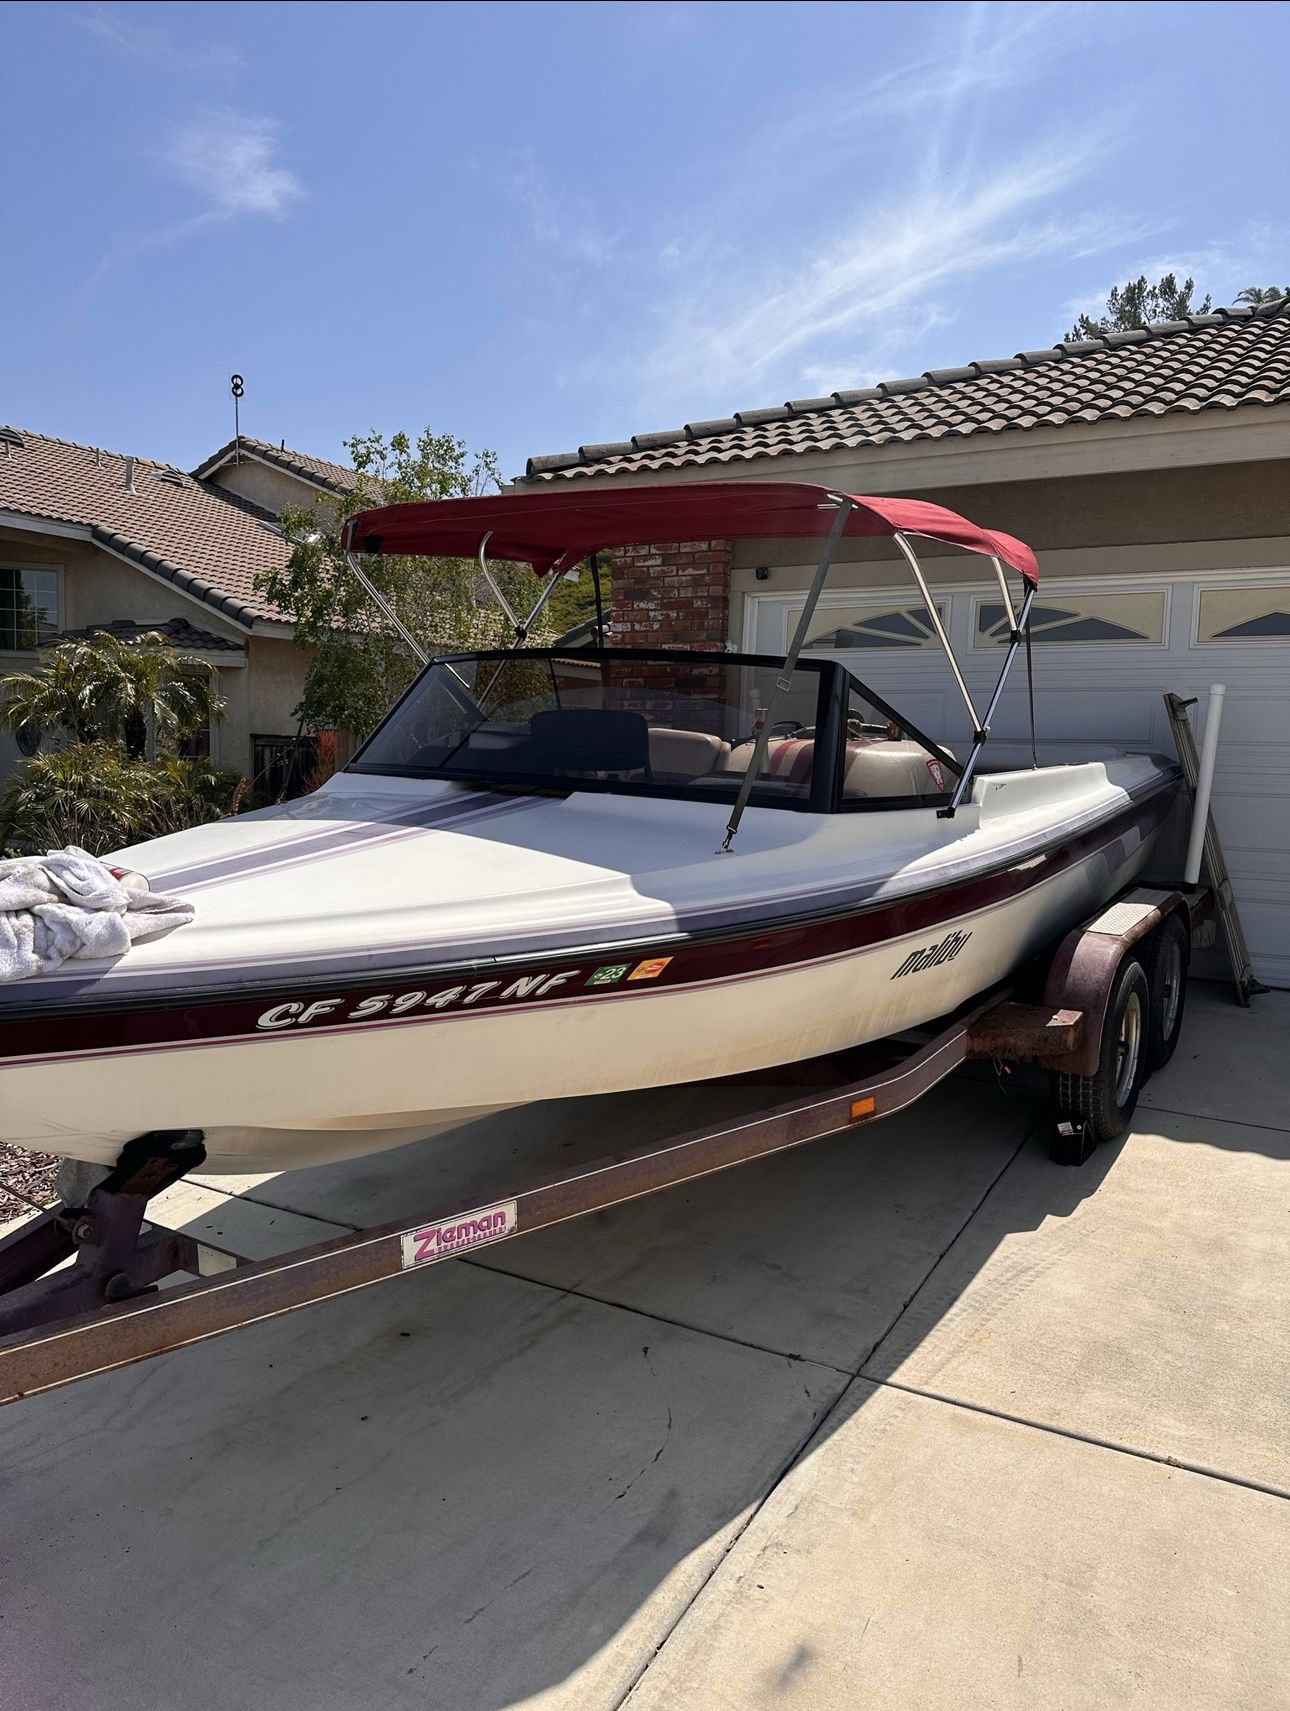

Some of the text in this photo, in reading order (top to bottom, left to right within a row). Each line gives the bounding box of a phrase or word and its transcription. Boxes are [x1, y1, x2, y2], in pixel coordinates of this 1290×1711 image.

[600, 967, 627, 980] 23
[890, 930, 973, 980] malibu
[256, 970, 581, 1029] CF 5947 NF
[414, 1211, 506, 1261] Zieman
